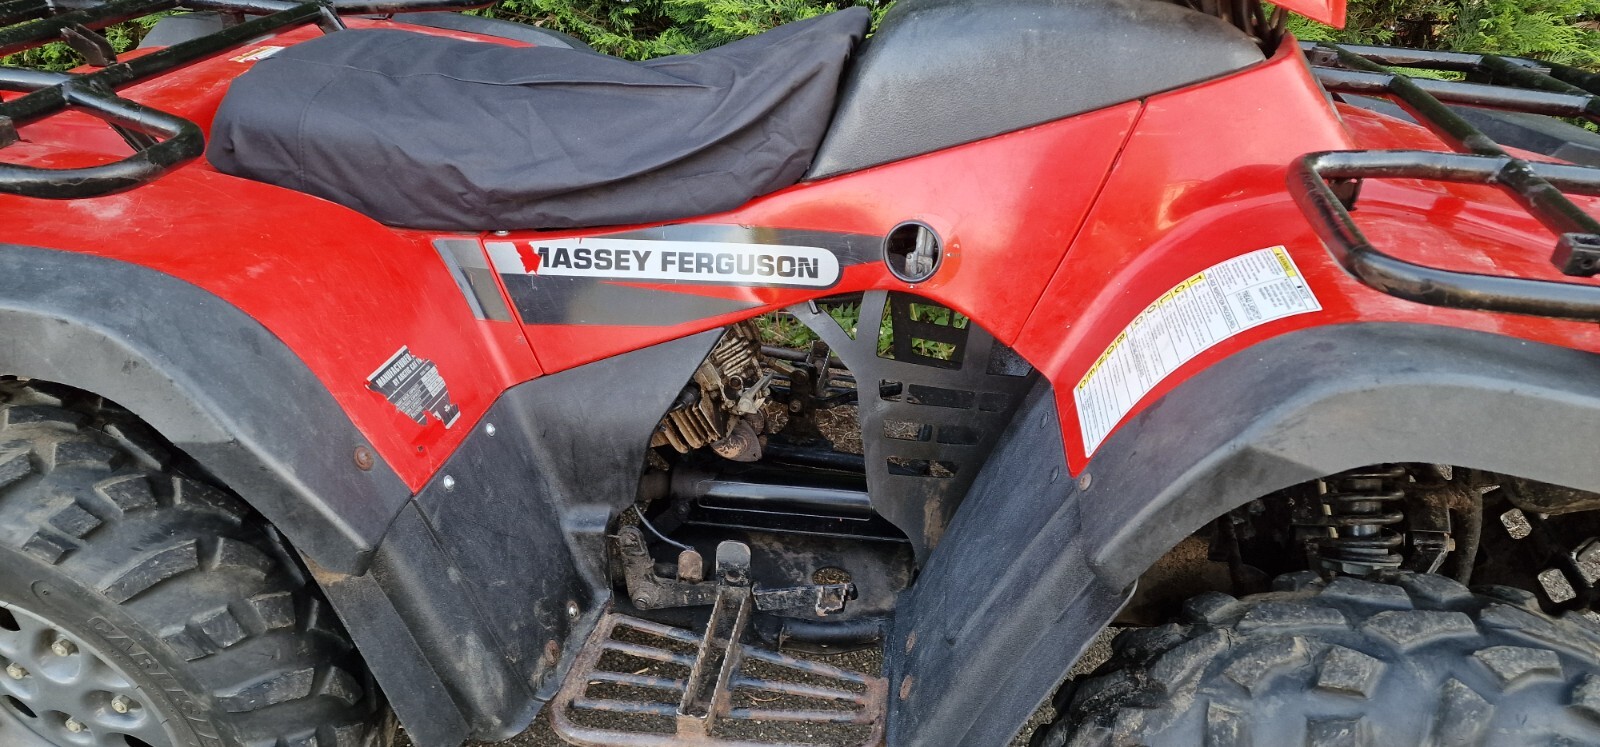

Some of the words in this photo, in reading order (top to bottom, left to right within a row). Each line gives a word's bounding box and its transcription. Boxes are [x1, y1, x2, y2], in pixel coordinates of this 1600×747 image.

[660, 251, 819, 279] FERGUSON
[375, 352, 412, 387] MANUFACTURED
[391, 377, 400, 386] BY
[396, 366, 412, 381] ARCTIC
[408, 360, 418, 370] CAT
